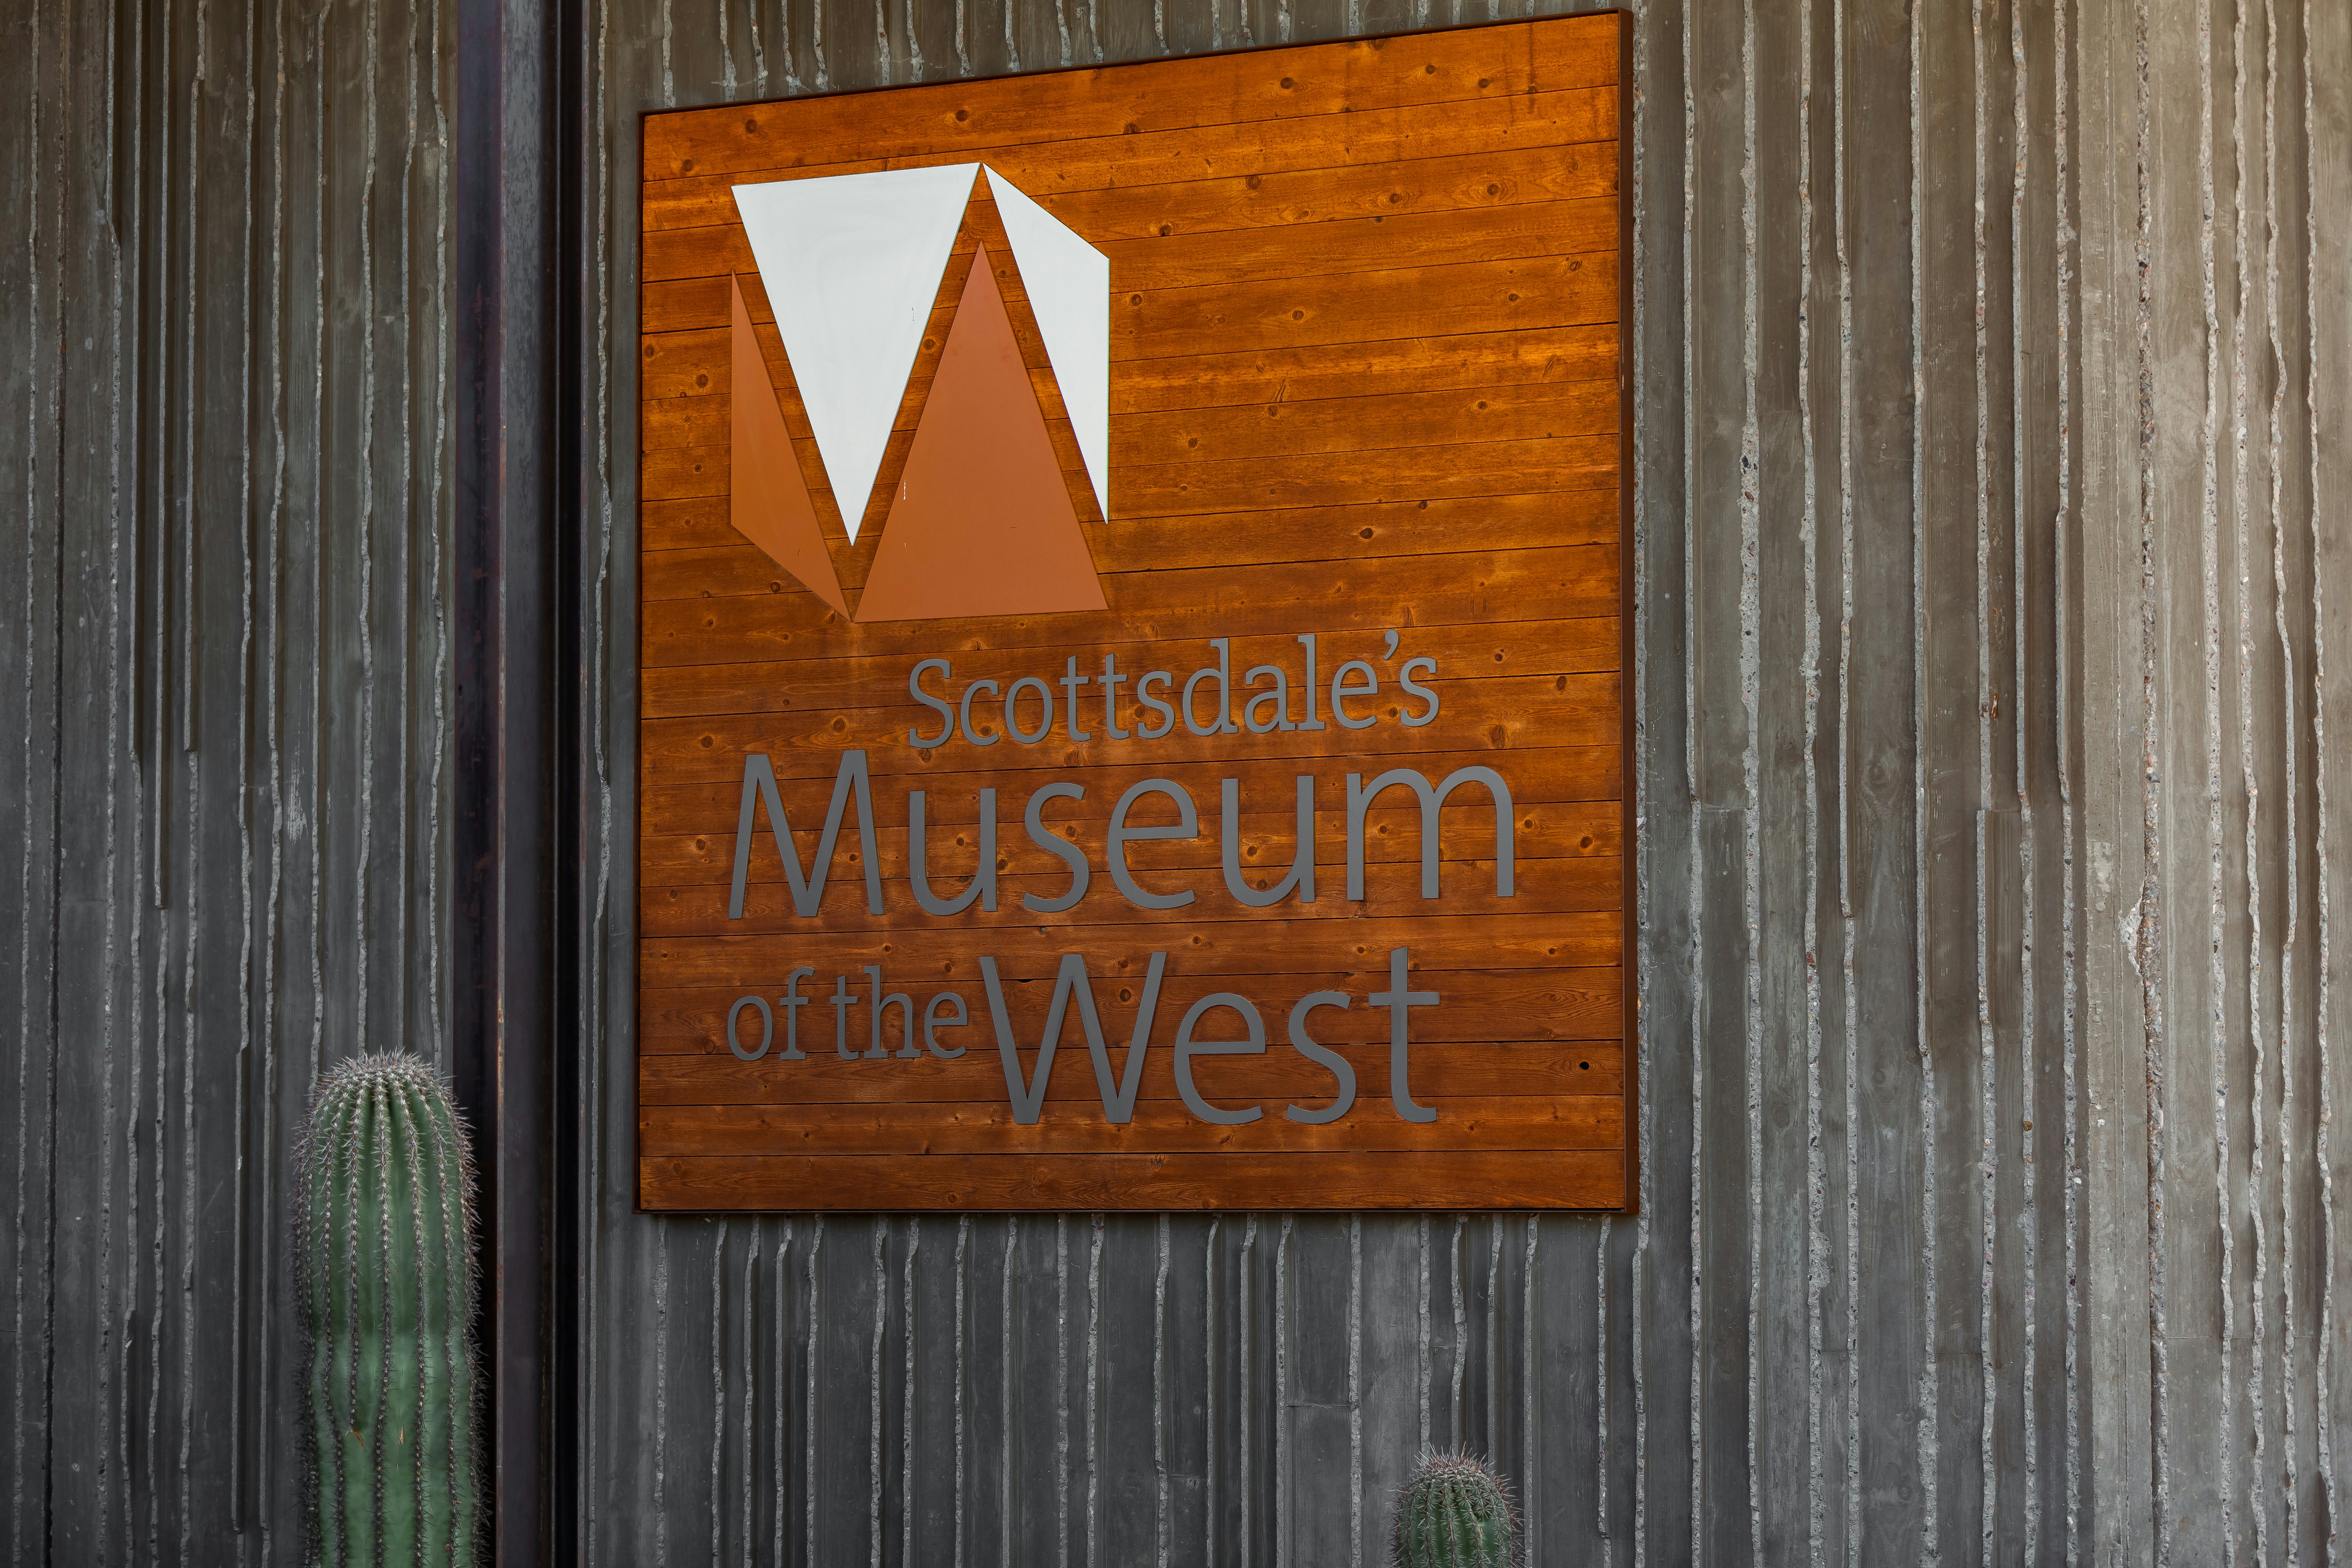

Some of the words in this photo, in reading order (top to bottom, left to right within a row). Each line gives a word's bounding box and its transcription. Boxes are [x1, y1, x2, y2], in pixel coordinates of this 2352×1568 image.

[909, 630, 1439, 749] Scottsdale's
[729, 750, 1514, 919] Museum
[727, 967, 818, 1061] of
[829, 964, 967, 1061] the
[979, 946, 1439, 1125] West
